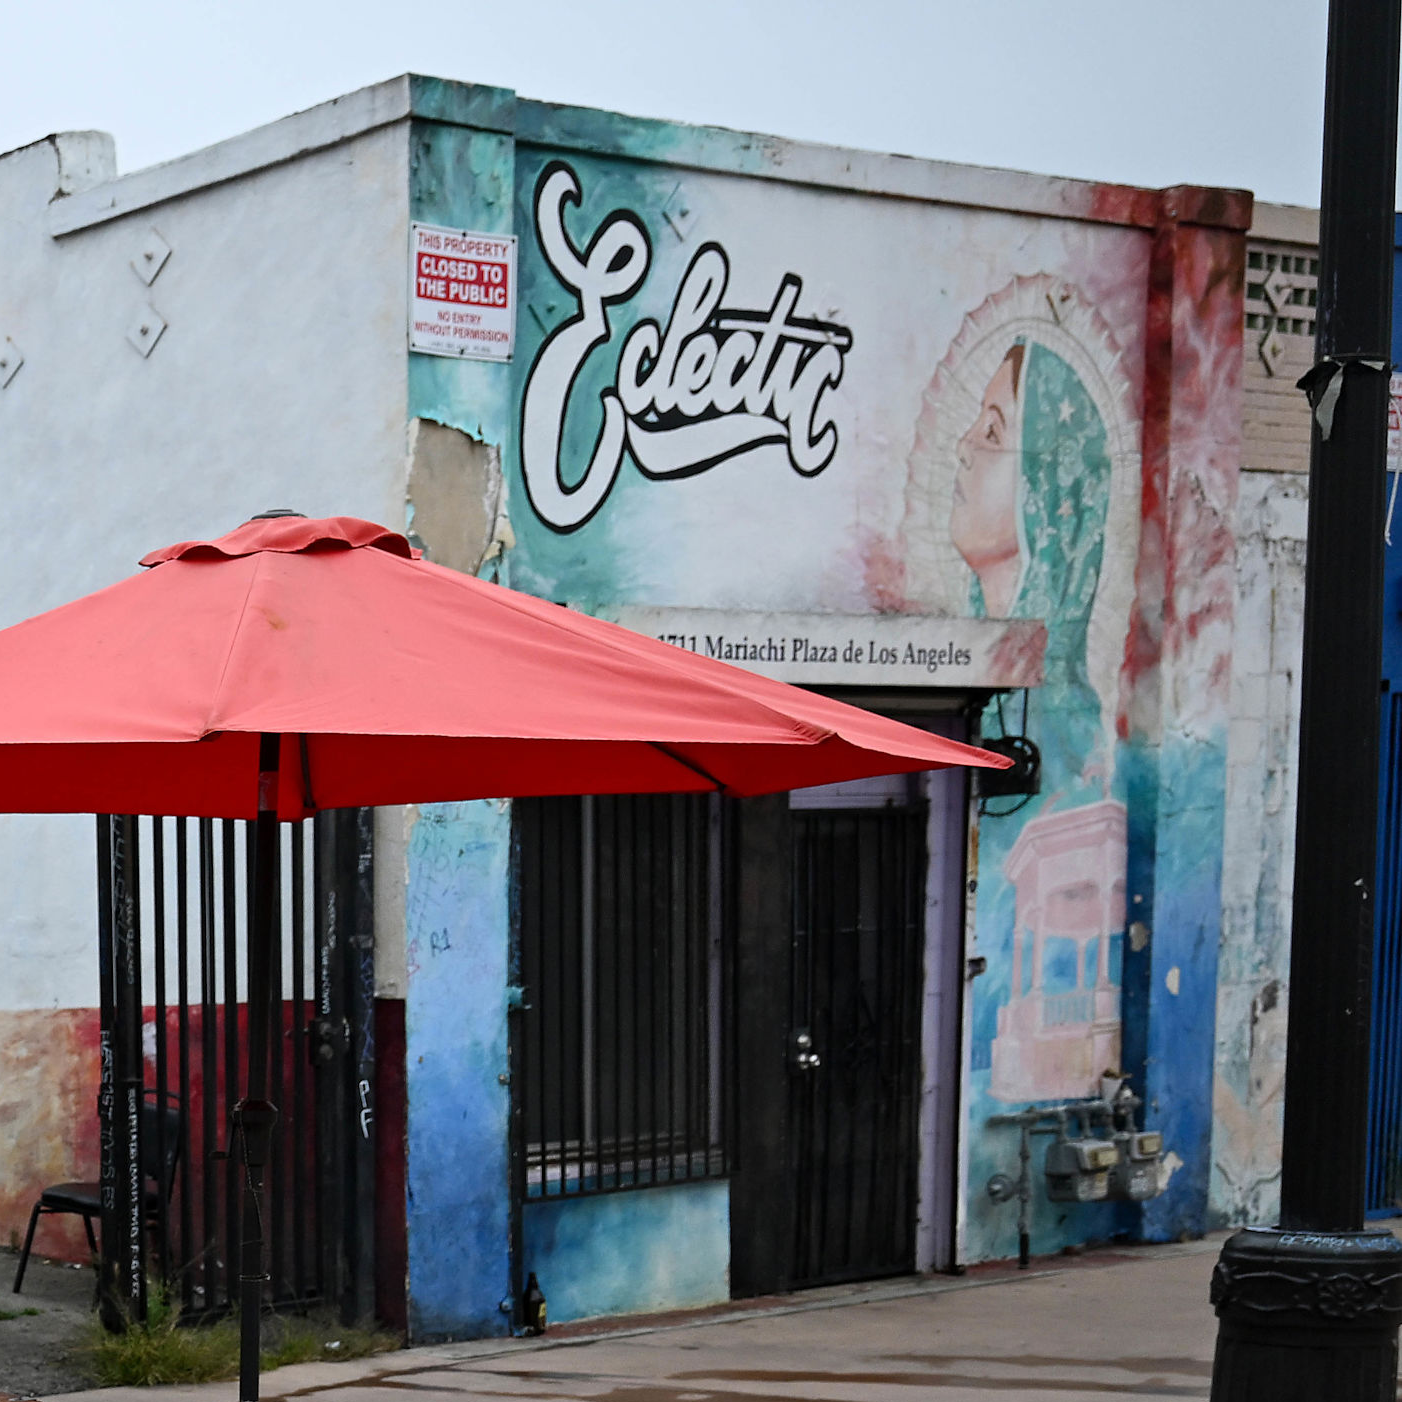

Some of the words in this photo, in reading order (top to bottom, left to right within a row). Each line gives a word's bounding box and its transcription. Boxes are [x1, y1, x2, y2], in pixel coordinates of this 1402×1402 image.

[419, 232, 442, 249] THIS
[444, 238, 509, 257] PROPERTY
[421, 256, 477, 281] CLOSED
[481, 264, 503, 284] TO
[418, 277, 447, 298] THE
[449, 282, 506, 305] PUBLIC
[415, 321, 451, 338] WITHOUT
[453, 327, 509, 343] PERMISSION
[438, 311, 451, 323] NO
[452, 313, 483, 326] ENTRY
[522, 160, 853, 535] Eclectic
[706, 635, 786, 662] Mariachi
[792, 638, 838, 665] Plaza
[843, 641, 865, 664] de
[869, 640, 898, 665] Los
[902, 641, 972, 674] Angeles
